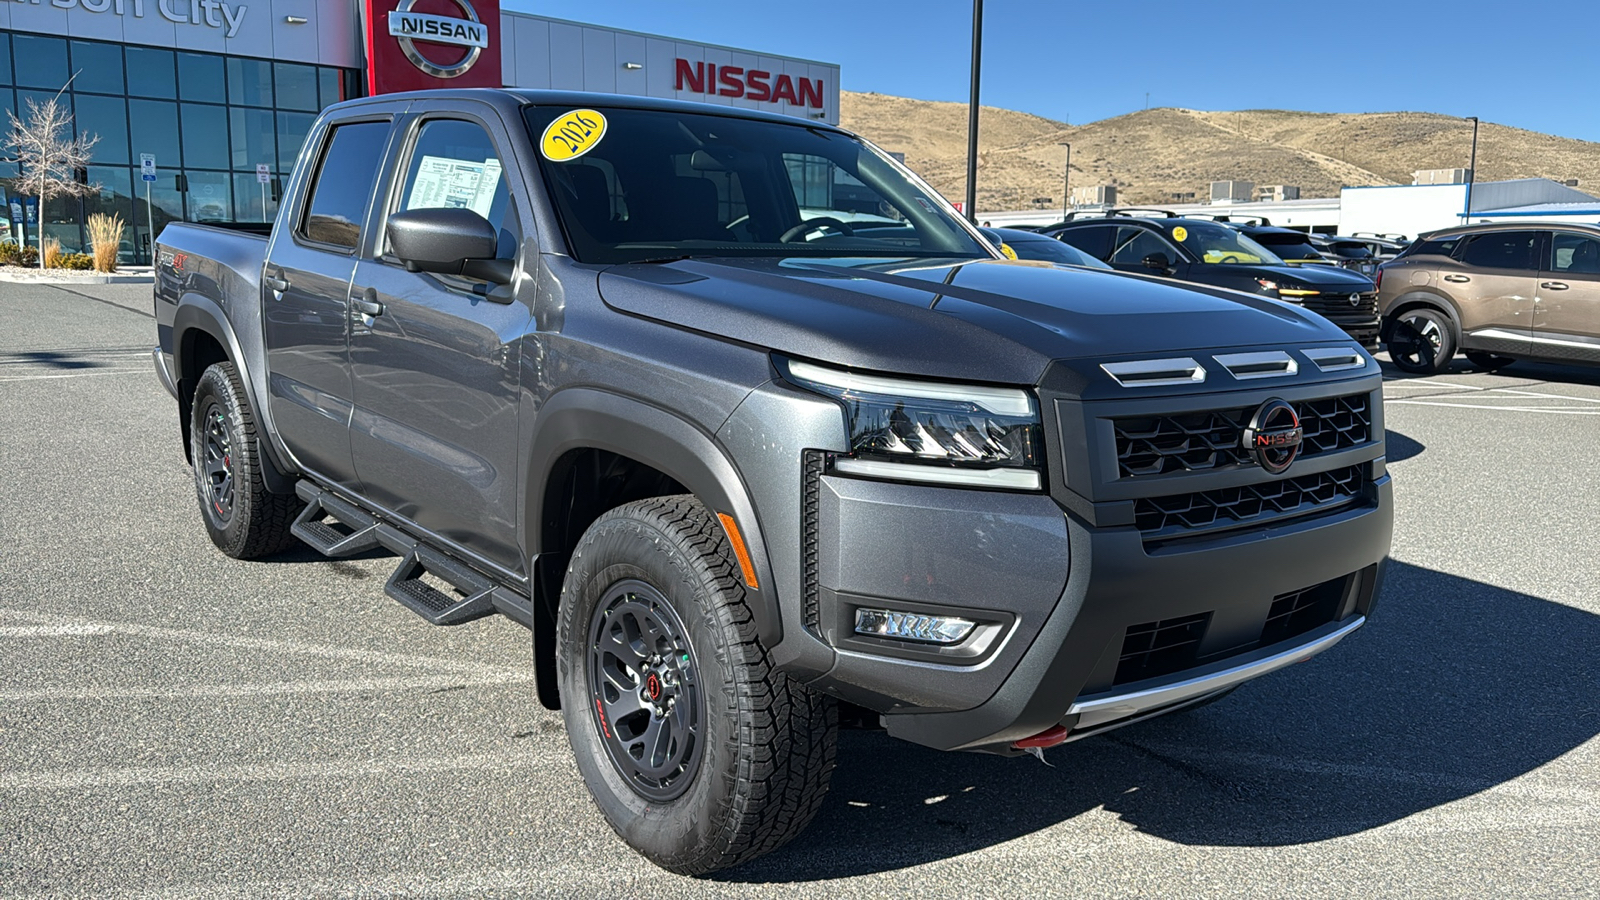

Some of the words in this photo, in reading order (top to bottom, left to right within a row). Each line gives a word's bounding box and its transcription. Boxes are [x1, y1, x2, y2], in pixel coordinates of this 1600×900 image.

[157, 0, 248, 38] City
[401, 17, 481, 42] NISSAN
[674, 57, 824, 109] NISSAN
[552, 112, 598, 154] 2026
